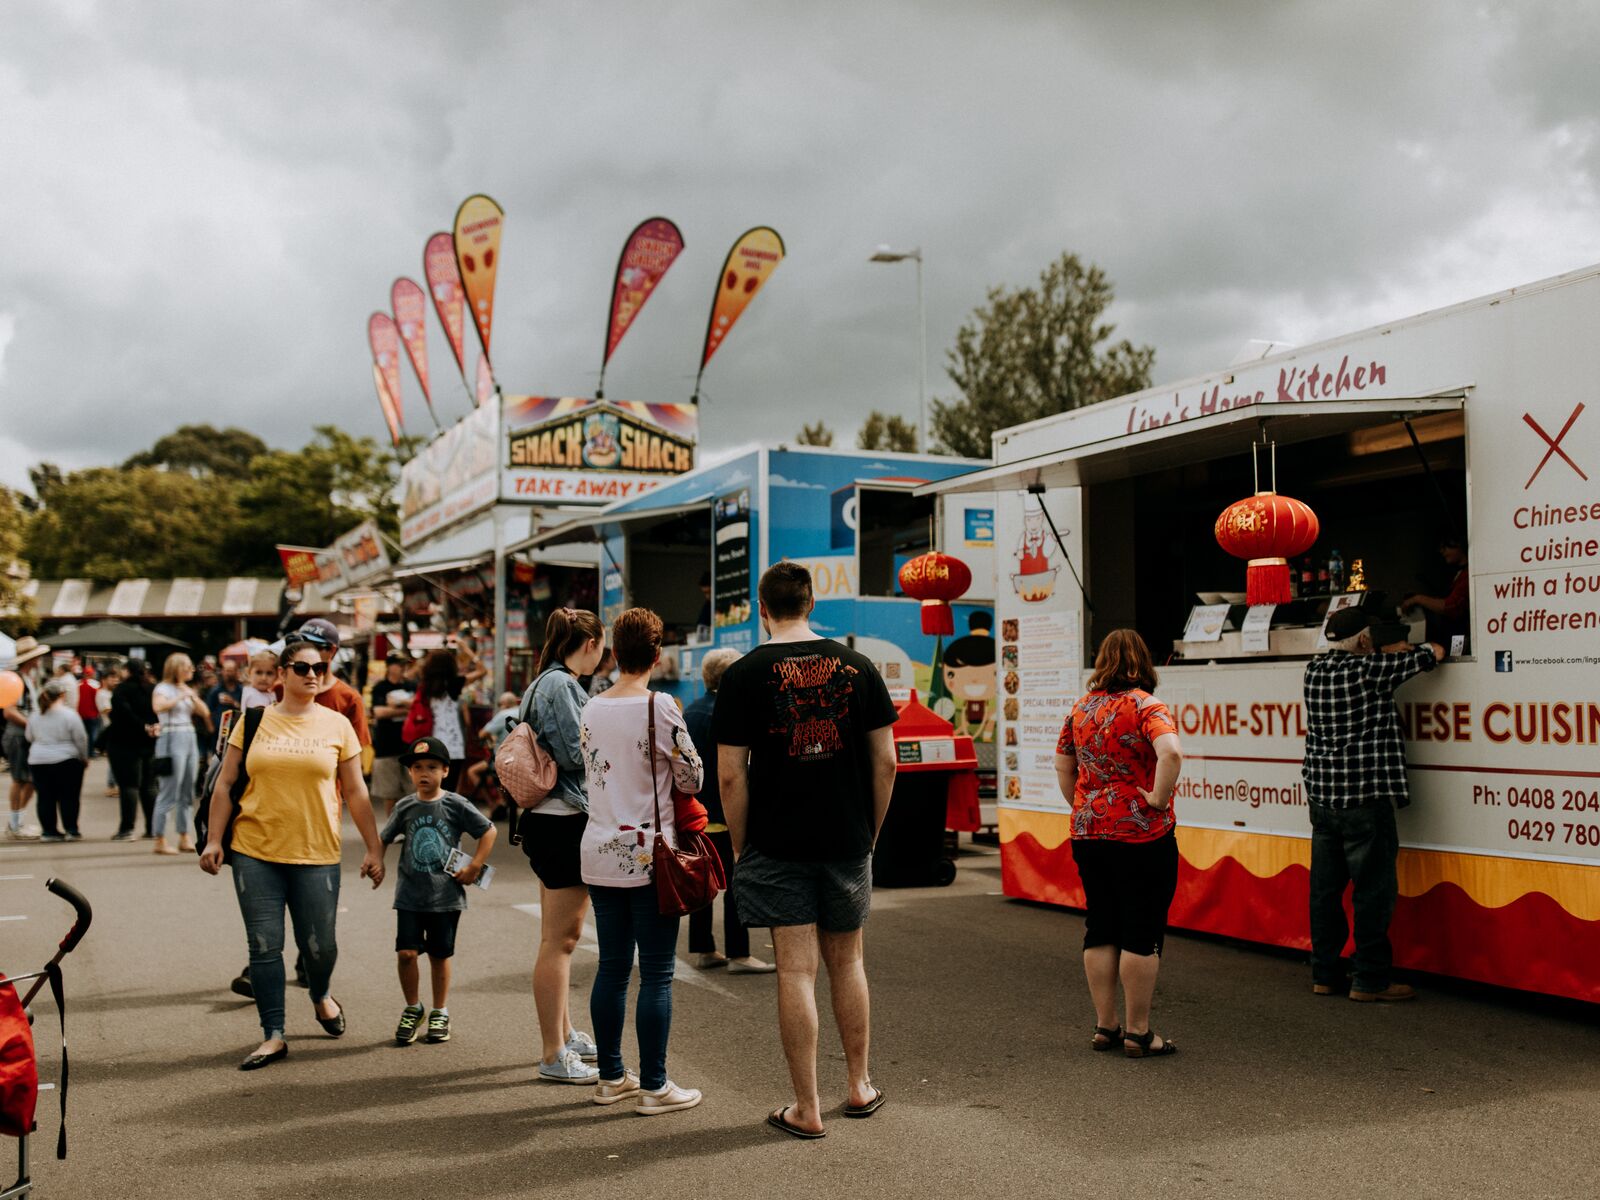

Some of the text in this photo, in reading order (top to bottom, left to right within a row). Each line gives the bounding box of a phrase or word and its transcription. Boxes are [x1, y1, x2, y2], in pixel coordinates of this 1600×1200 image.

[1277, 355, 1387, 402] Kitchen
[511, 421, 690, 471] SNACK SHACK
[515, 477, 631, 497] TAKE-AWAY
[1513, 503, 1600, 529] Chinese
[1520, 537, 1599, 563] cuisine
[1494, 572, 1600, 599] with a tou
[1487, 608, 1600, 634] of differen
[1168, 702, 1308, 737] HOME-STYL
[1473, 785, 1600, 813] Ph: 0408 204
[1508, 818, 1600, 847] 0429 780
